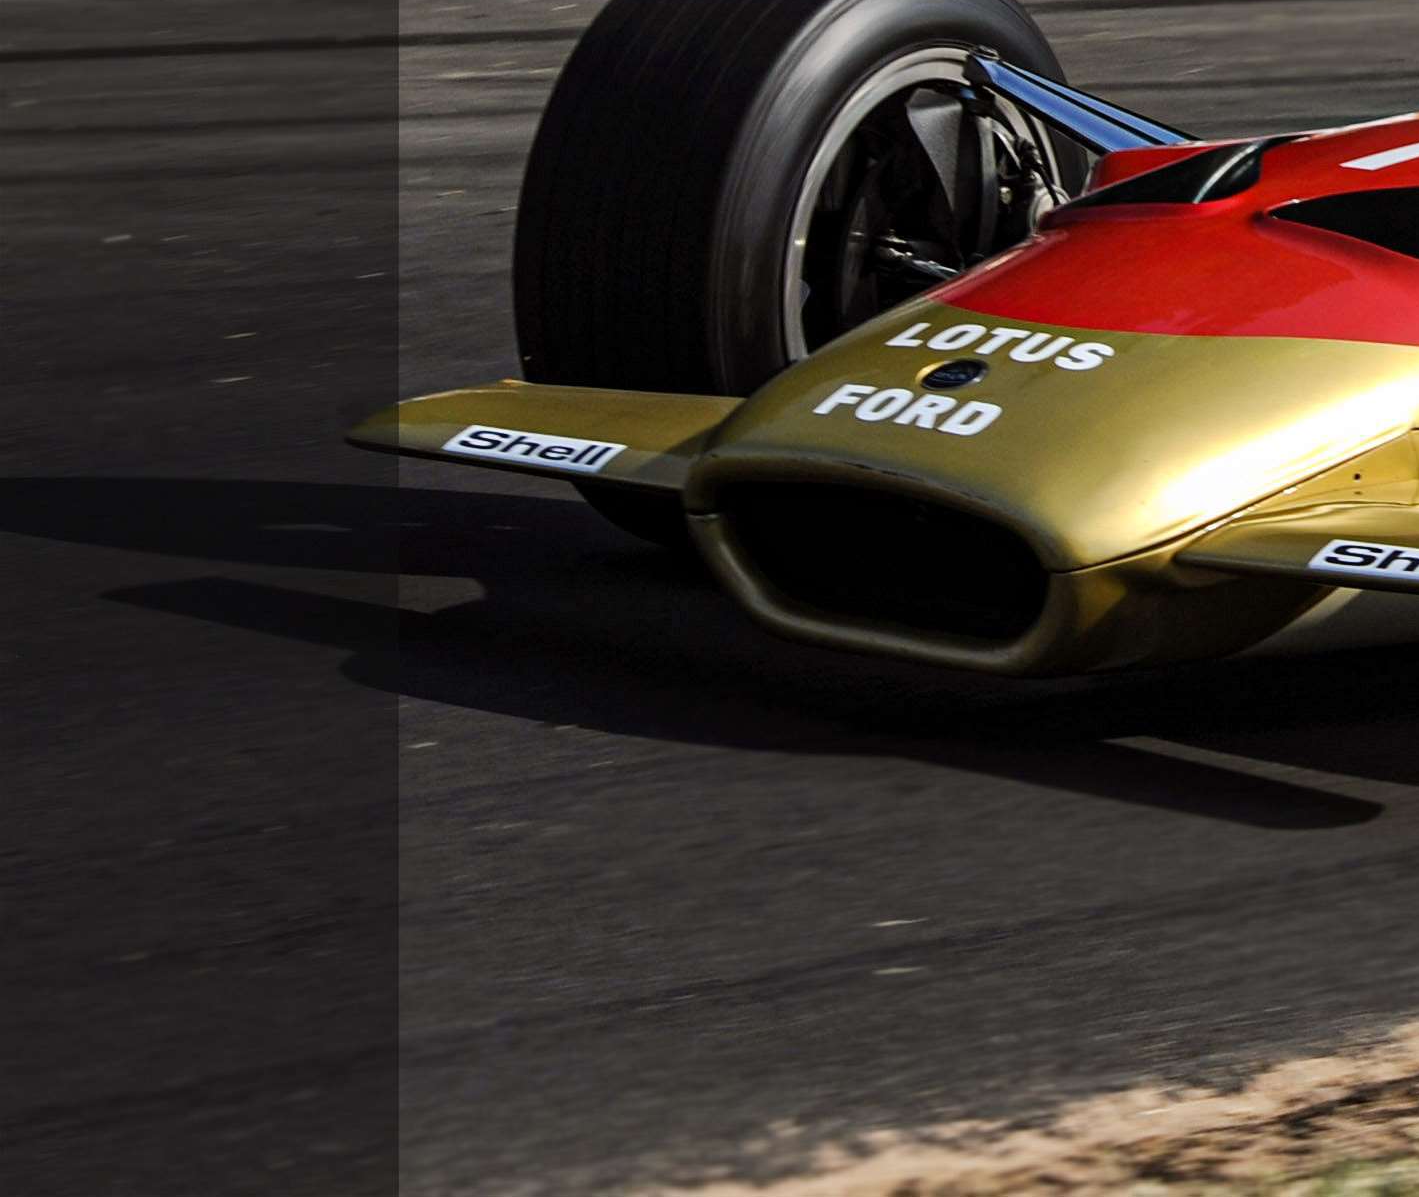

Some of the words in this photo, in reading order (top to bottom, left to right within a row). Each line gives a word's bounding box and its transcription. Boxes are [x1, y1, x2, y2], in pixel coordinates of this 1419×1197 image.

[885, 321, 1116, 372] LOTUS
[813, 384, 1002, 437] FORD
[458, 430, 612, 466] Shell
